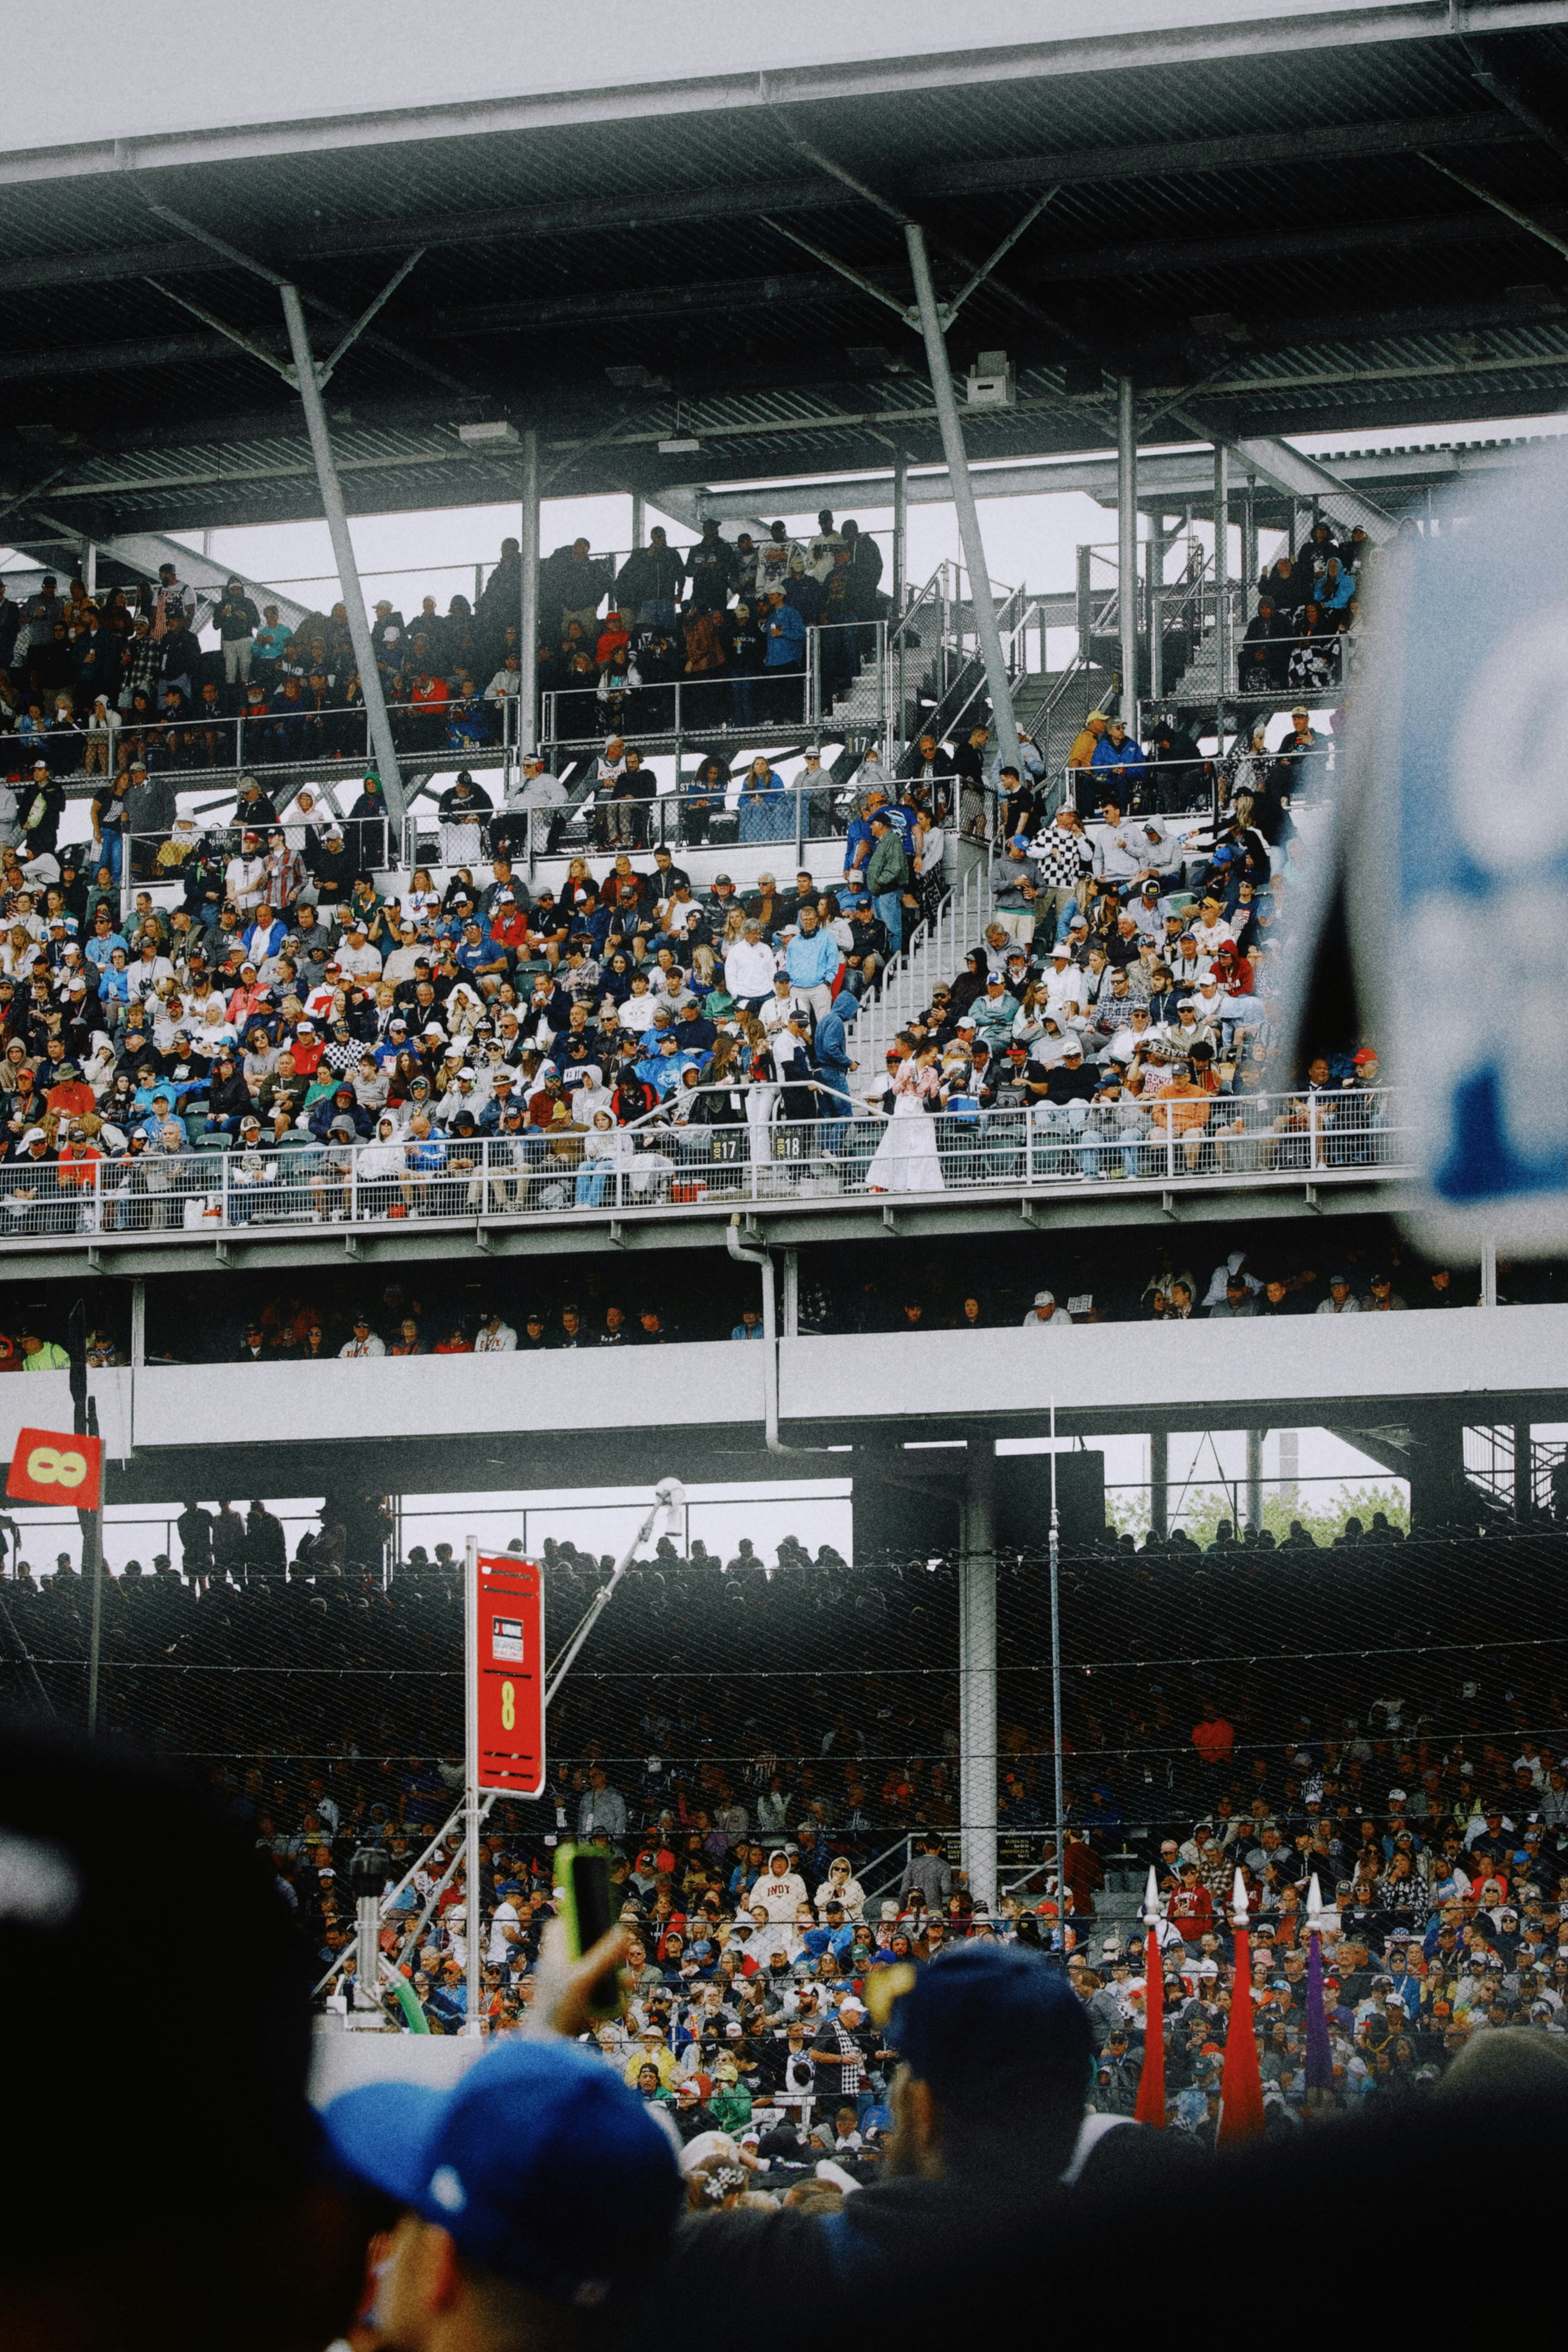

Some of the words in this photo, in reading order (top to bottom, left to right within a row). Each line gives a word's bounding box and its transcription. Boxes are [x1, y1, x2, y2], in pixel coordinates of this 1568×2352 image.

[854, 737, 867, 753] 17
[216, 830, 228, 839] NO
[722, 1141, 737, 1159] 17
[785, 1137, 800, 1155] 18
[26, 1447, 87, 1488] 8
[501, 1680, 515, 1731] 8
[767, 1884, 790, 1897] INDY
